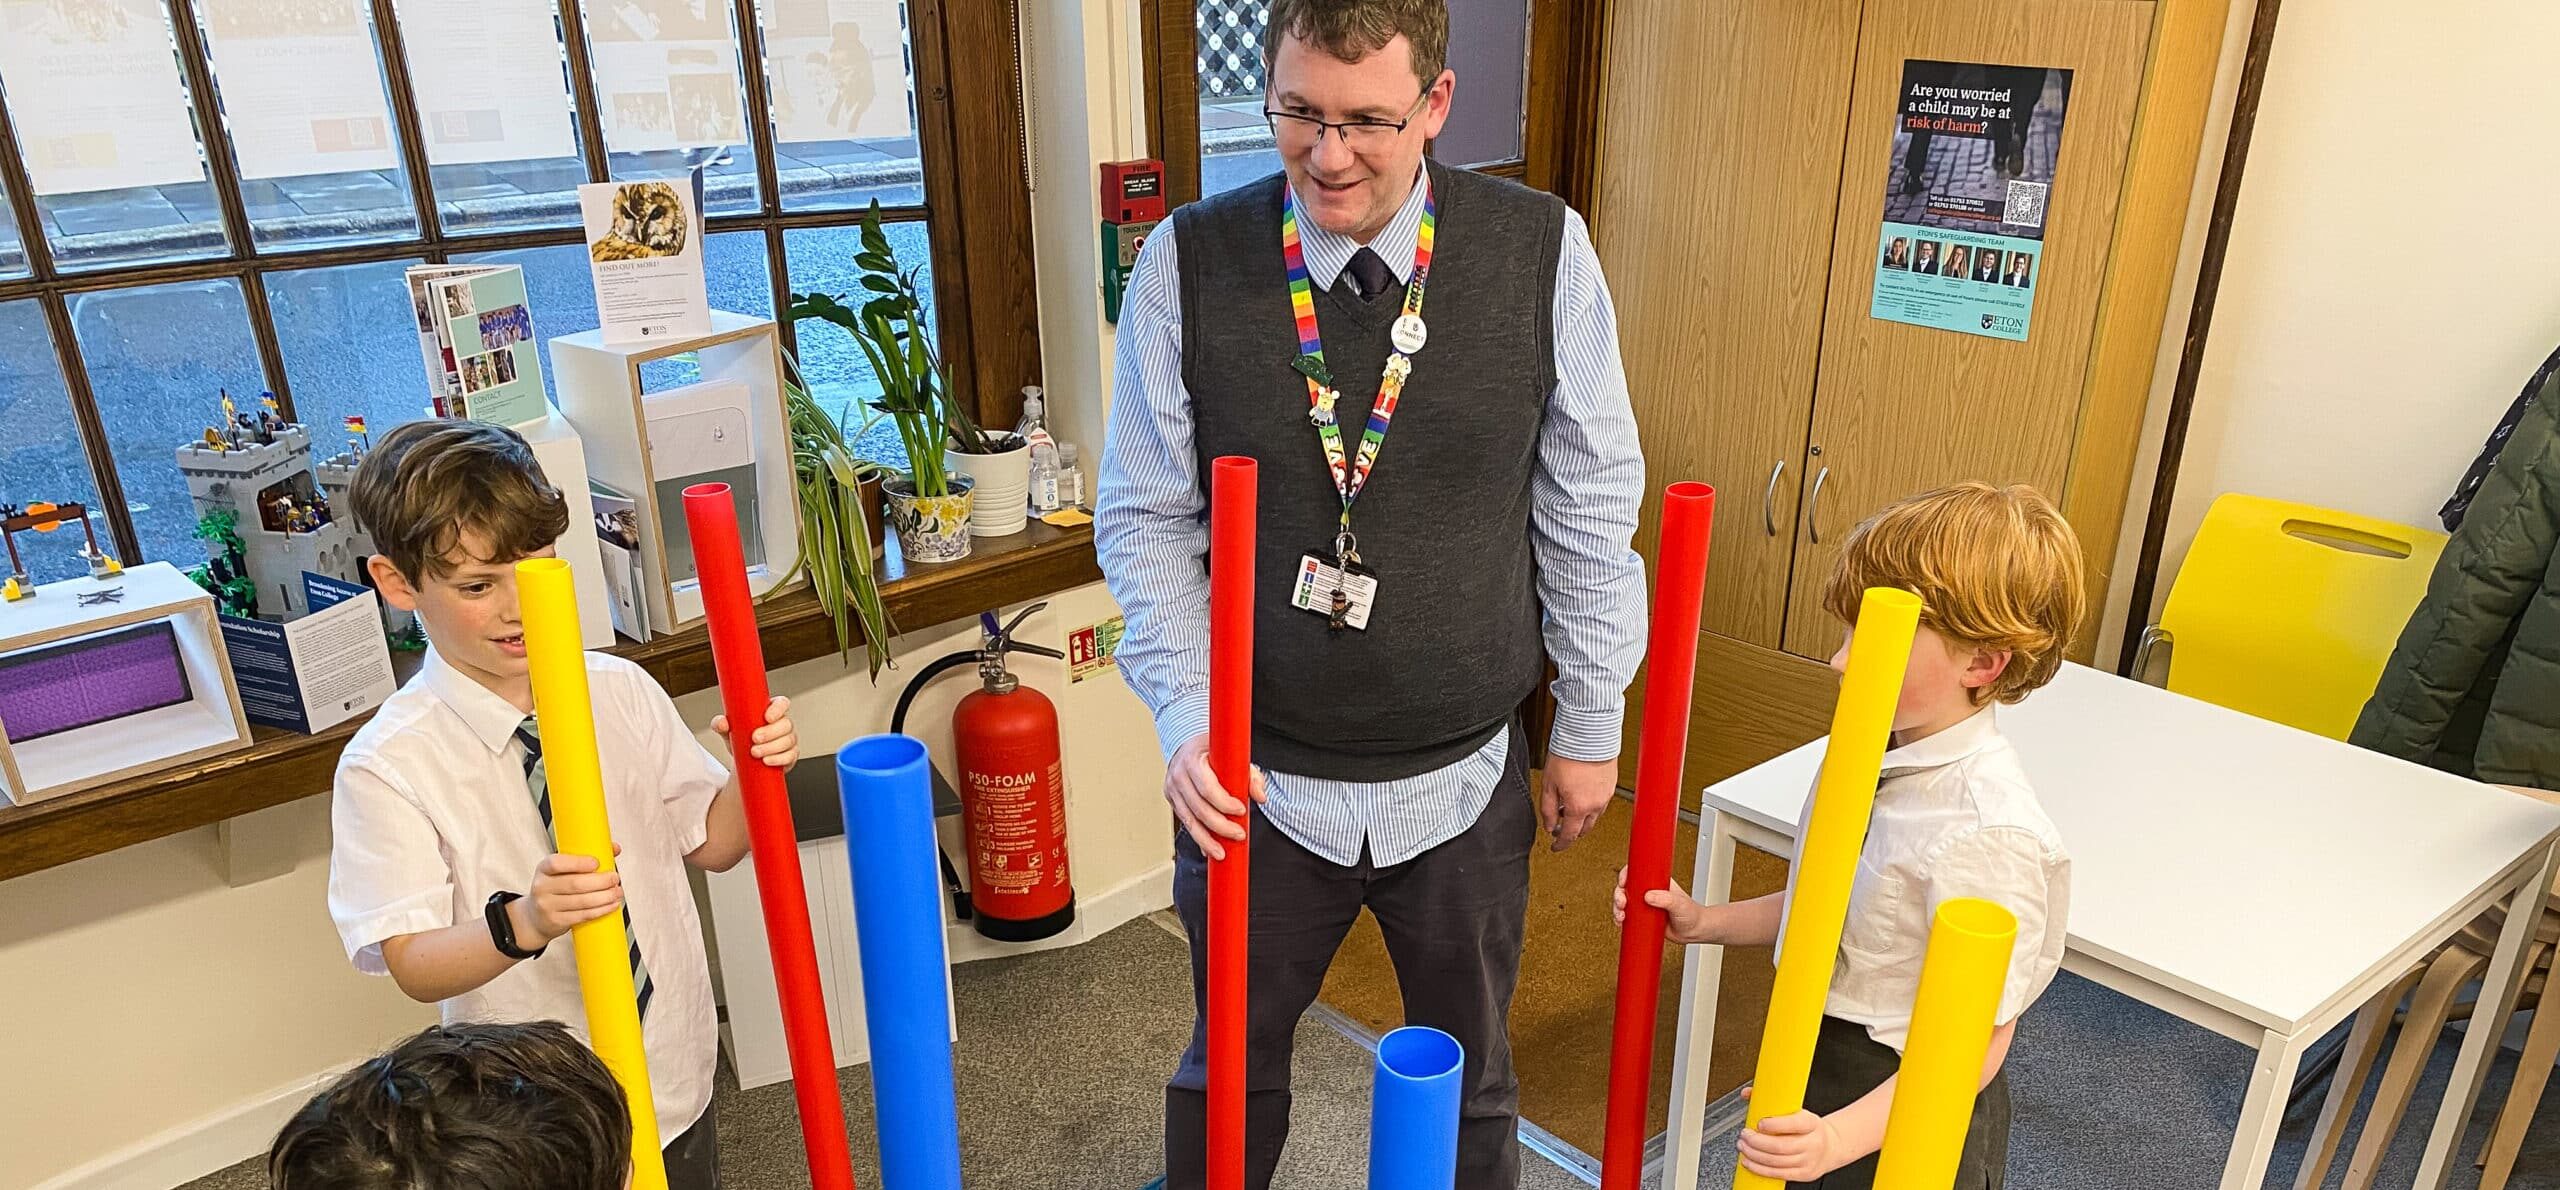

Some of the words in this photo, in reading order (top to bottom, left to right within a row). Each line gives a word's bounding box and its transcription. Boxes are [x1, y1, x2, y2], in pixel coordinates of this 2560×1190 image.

[1910, 83, 1933, 97] Are
[1934, 87, 1958, 100] you
[1960, 88, 2011, 102] worried
[1908, 101, 1916, 112] a
[1918, 100, 1950, 114] child
[1951, 105, 1979, 119] may
[1980, 104, 1996, 118] be
[1998, 107, 2011, 119] at
[1907, 116, 1931, 129] risk
[1933, 118, 1948, 130] of
[1948, 118, 1988, 134] harm?
[1123, 226, 1141, 234] TOUCH
[1918, 230, 1938, 238] ETON'S
[1939, 232, 1987, 244] SAFEGUARDING
[619, 262, 635, 271] OUT
[1993, 315, 2024, 328] ETON
[1396, 329, 1424, 342] ONNECT
[1992, 325, 2022, 334] COLLEGE
[474, 390, 501, 404] CONTACT
[247, 625, 280, 639] Scholarship
[968, 770, 1036, 787] P50-FOAM
[986, 784, 1031, 793] EXTINGUISHER
